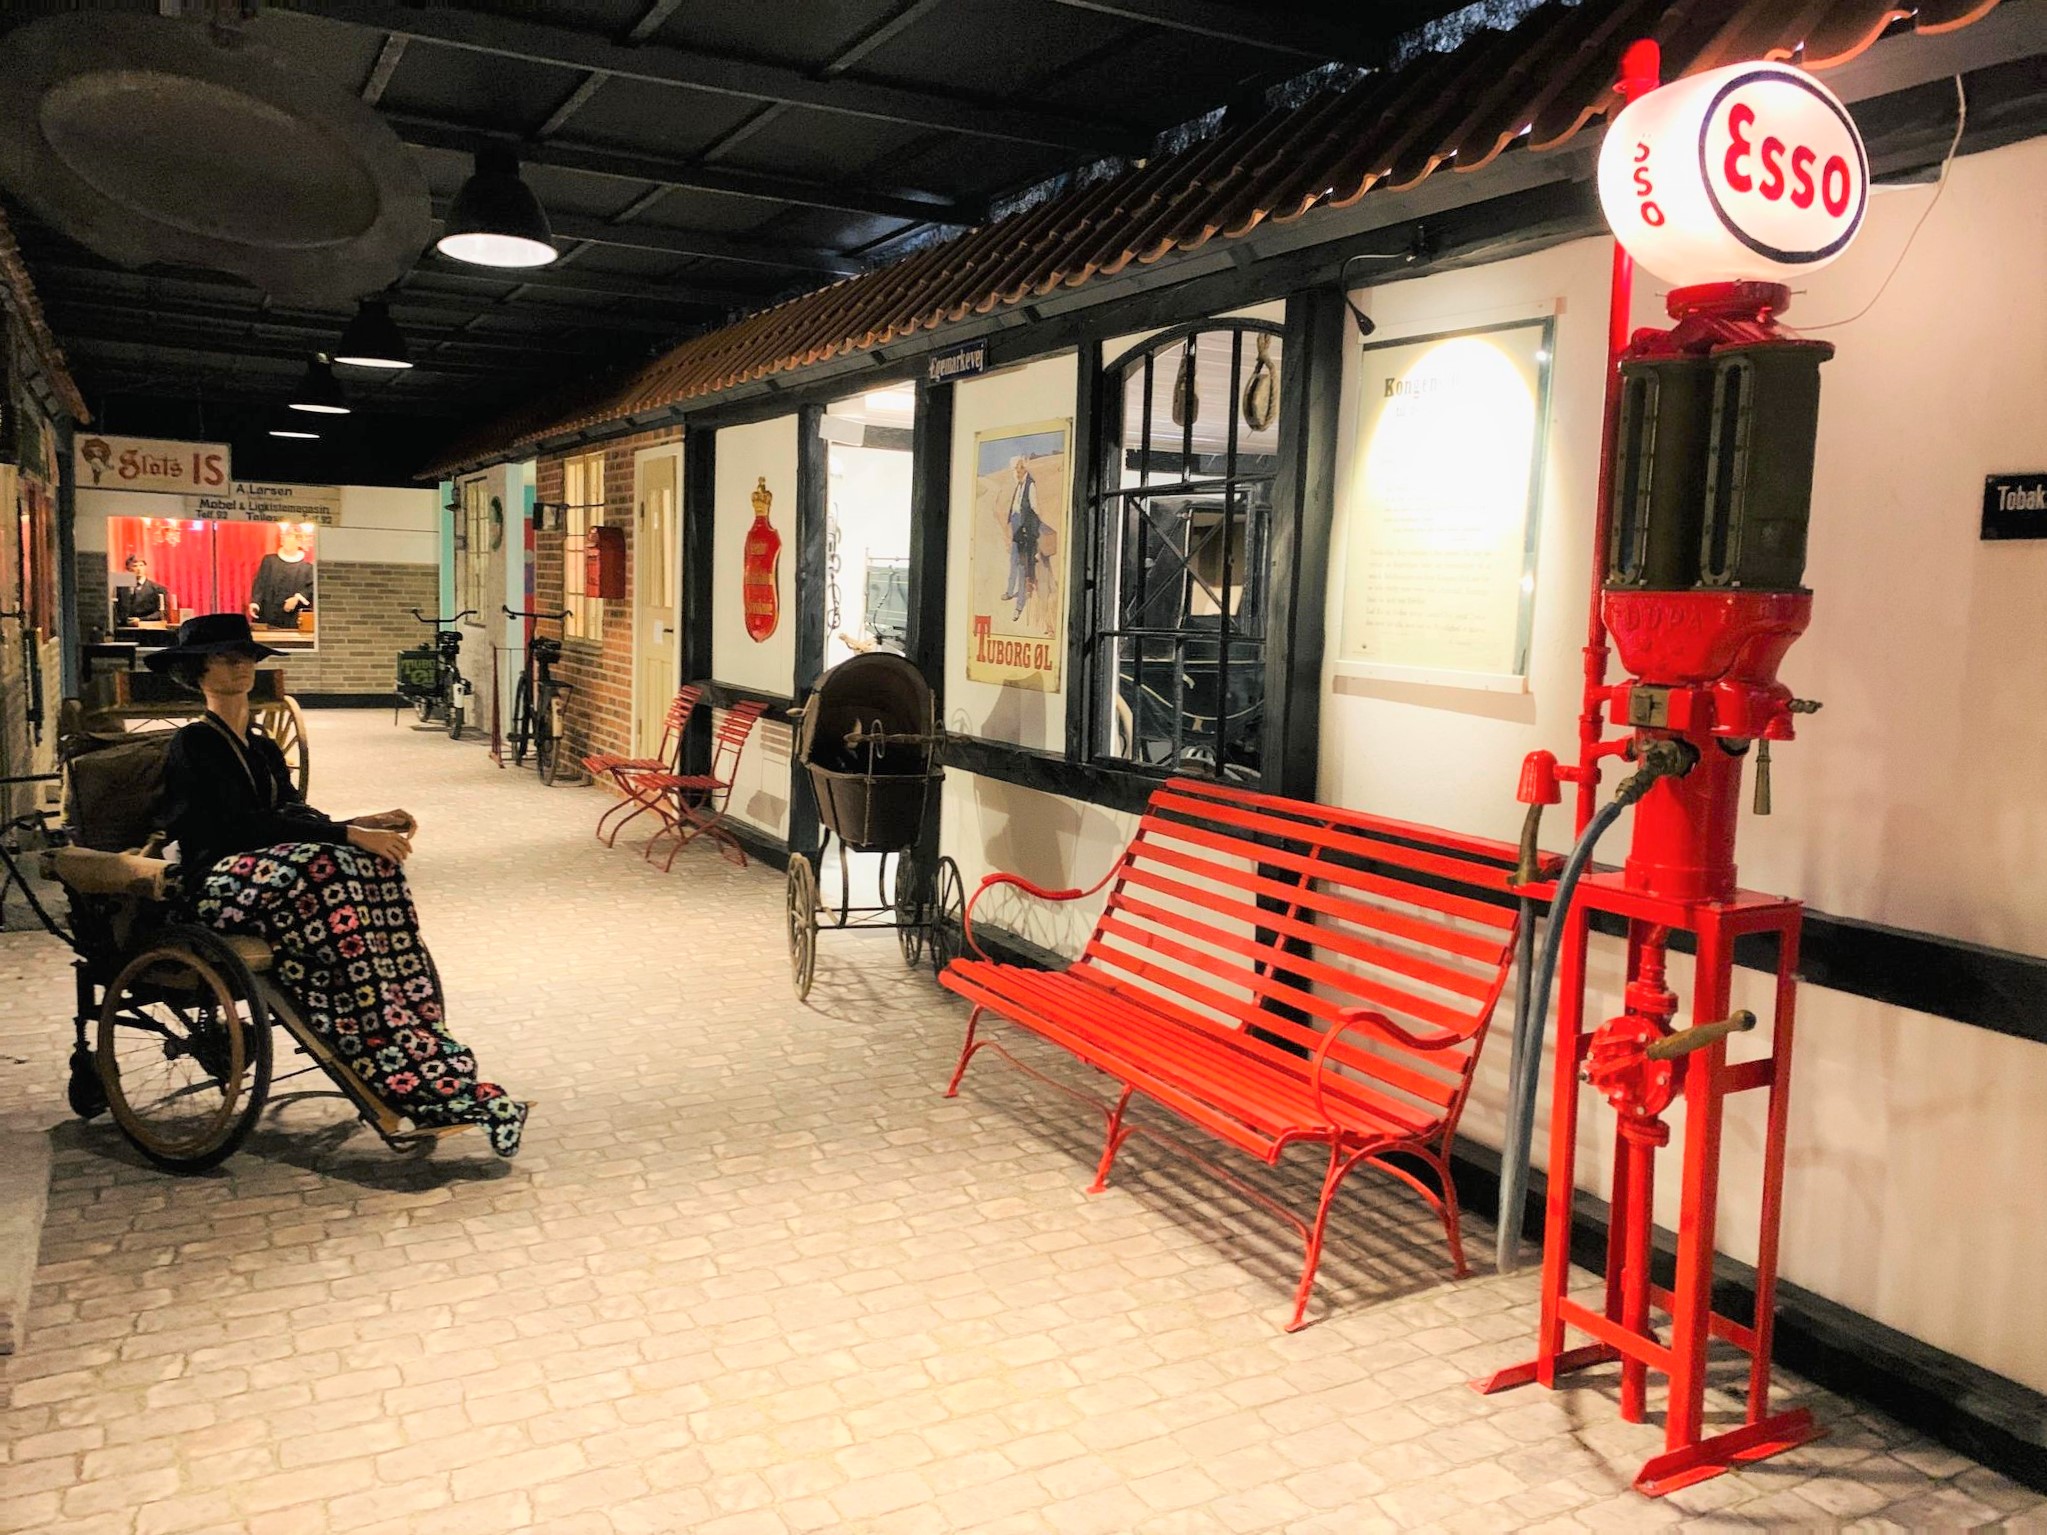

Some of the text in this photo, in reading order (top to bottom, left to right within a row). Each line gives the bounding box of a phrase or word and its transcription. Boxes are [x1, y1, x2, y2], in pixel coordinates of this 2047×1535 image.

[193, 453, 224, 486] IS
[249, 484, 293, 496] Larsen
[1997, 484, 2047, 511] Tobak
[1034, 643, 1053, 671] ØL
